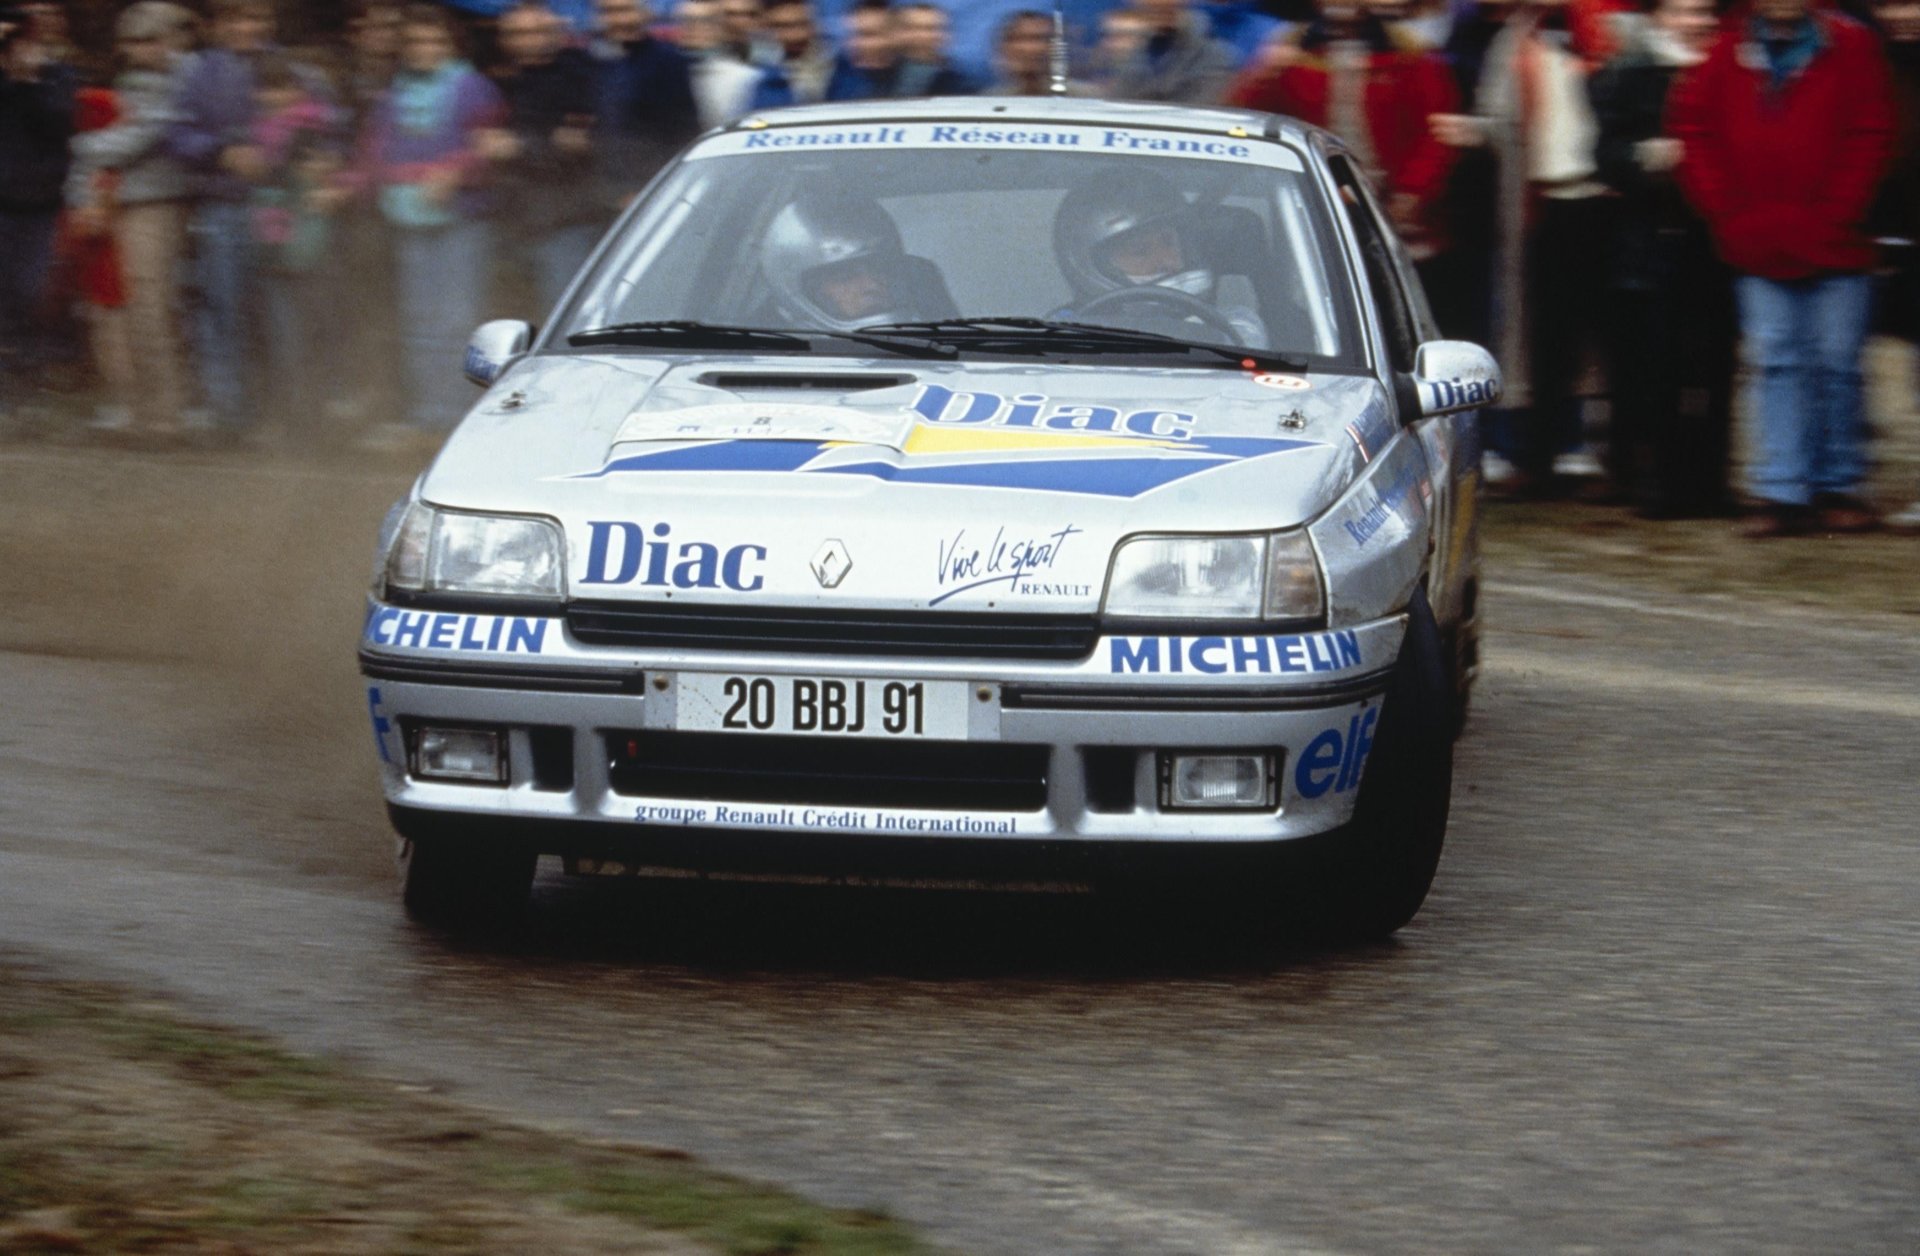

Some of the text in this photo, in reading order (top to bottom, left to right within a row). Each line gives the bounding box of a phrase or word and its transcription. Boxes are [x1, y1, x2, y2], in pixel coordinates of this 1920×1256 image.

[744, 126, 1250, 157] Renault Réseau France
[911, 383, 1198, 440] Diac
[1429, 377, 1497, 409] Diac
[579, 521, 767, 591] Diac
[939, 529, 982, 585] Vive
[1021, 584, 1092, 596] RENAULT
[1110, 629, 1362, 673] MICHELIN
[722, 677, 923, 734] 20 BBJ 91
[1295, 706, 1377, 799] elf
[635, 804, 1017, 834] groupe Renault Crédit International
